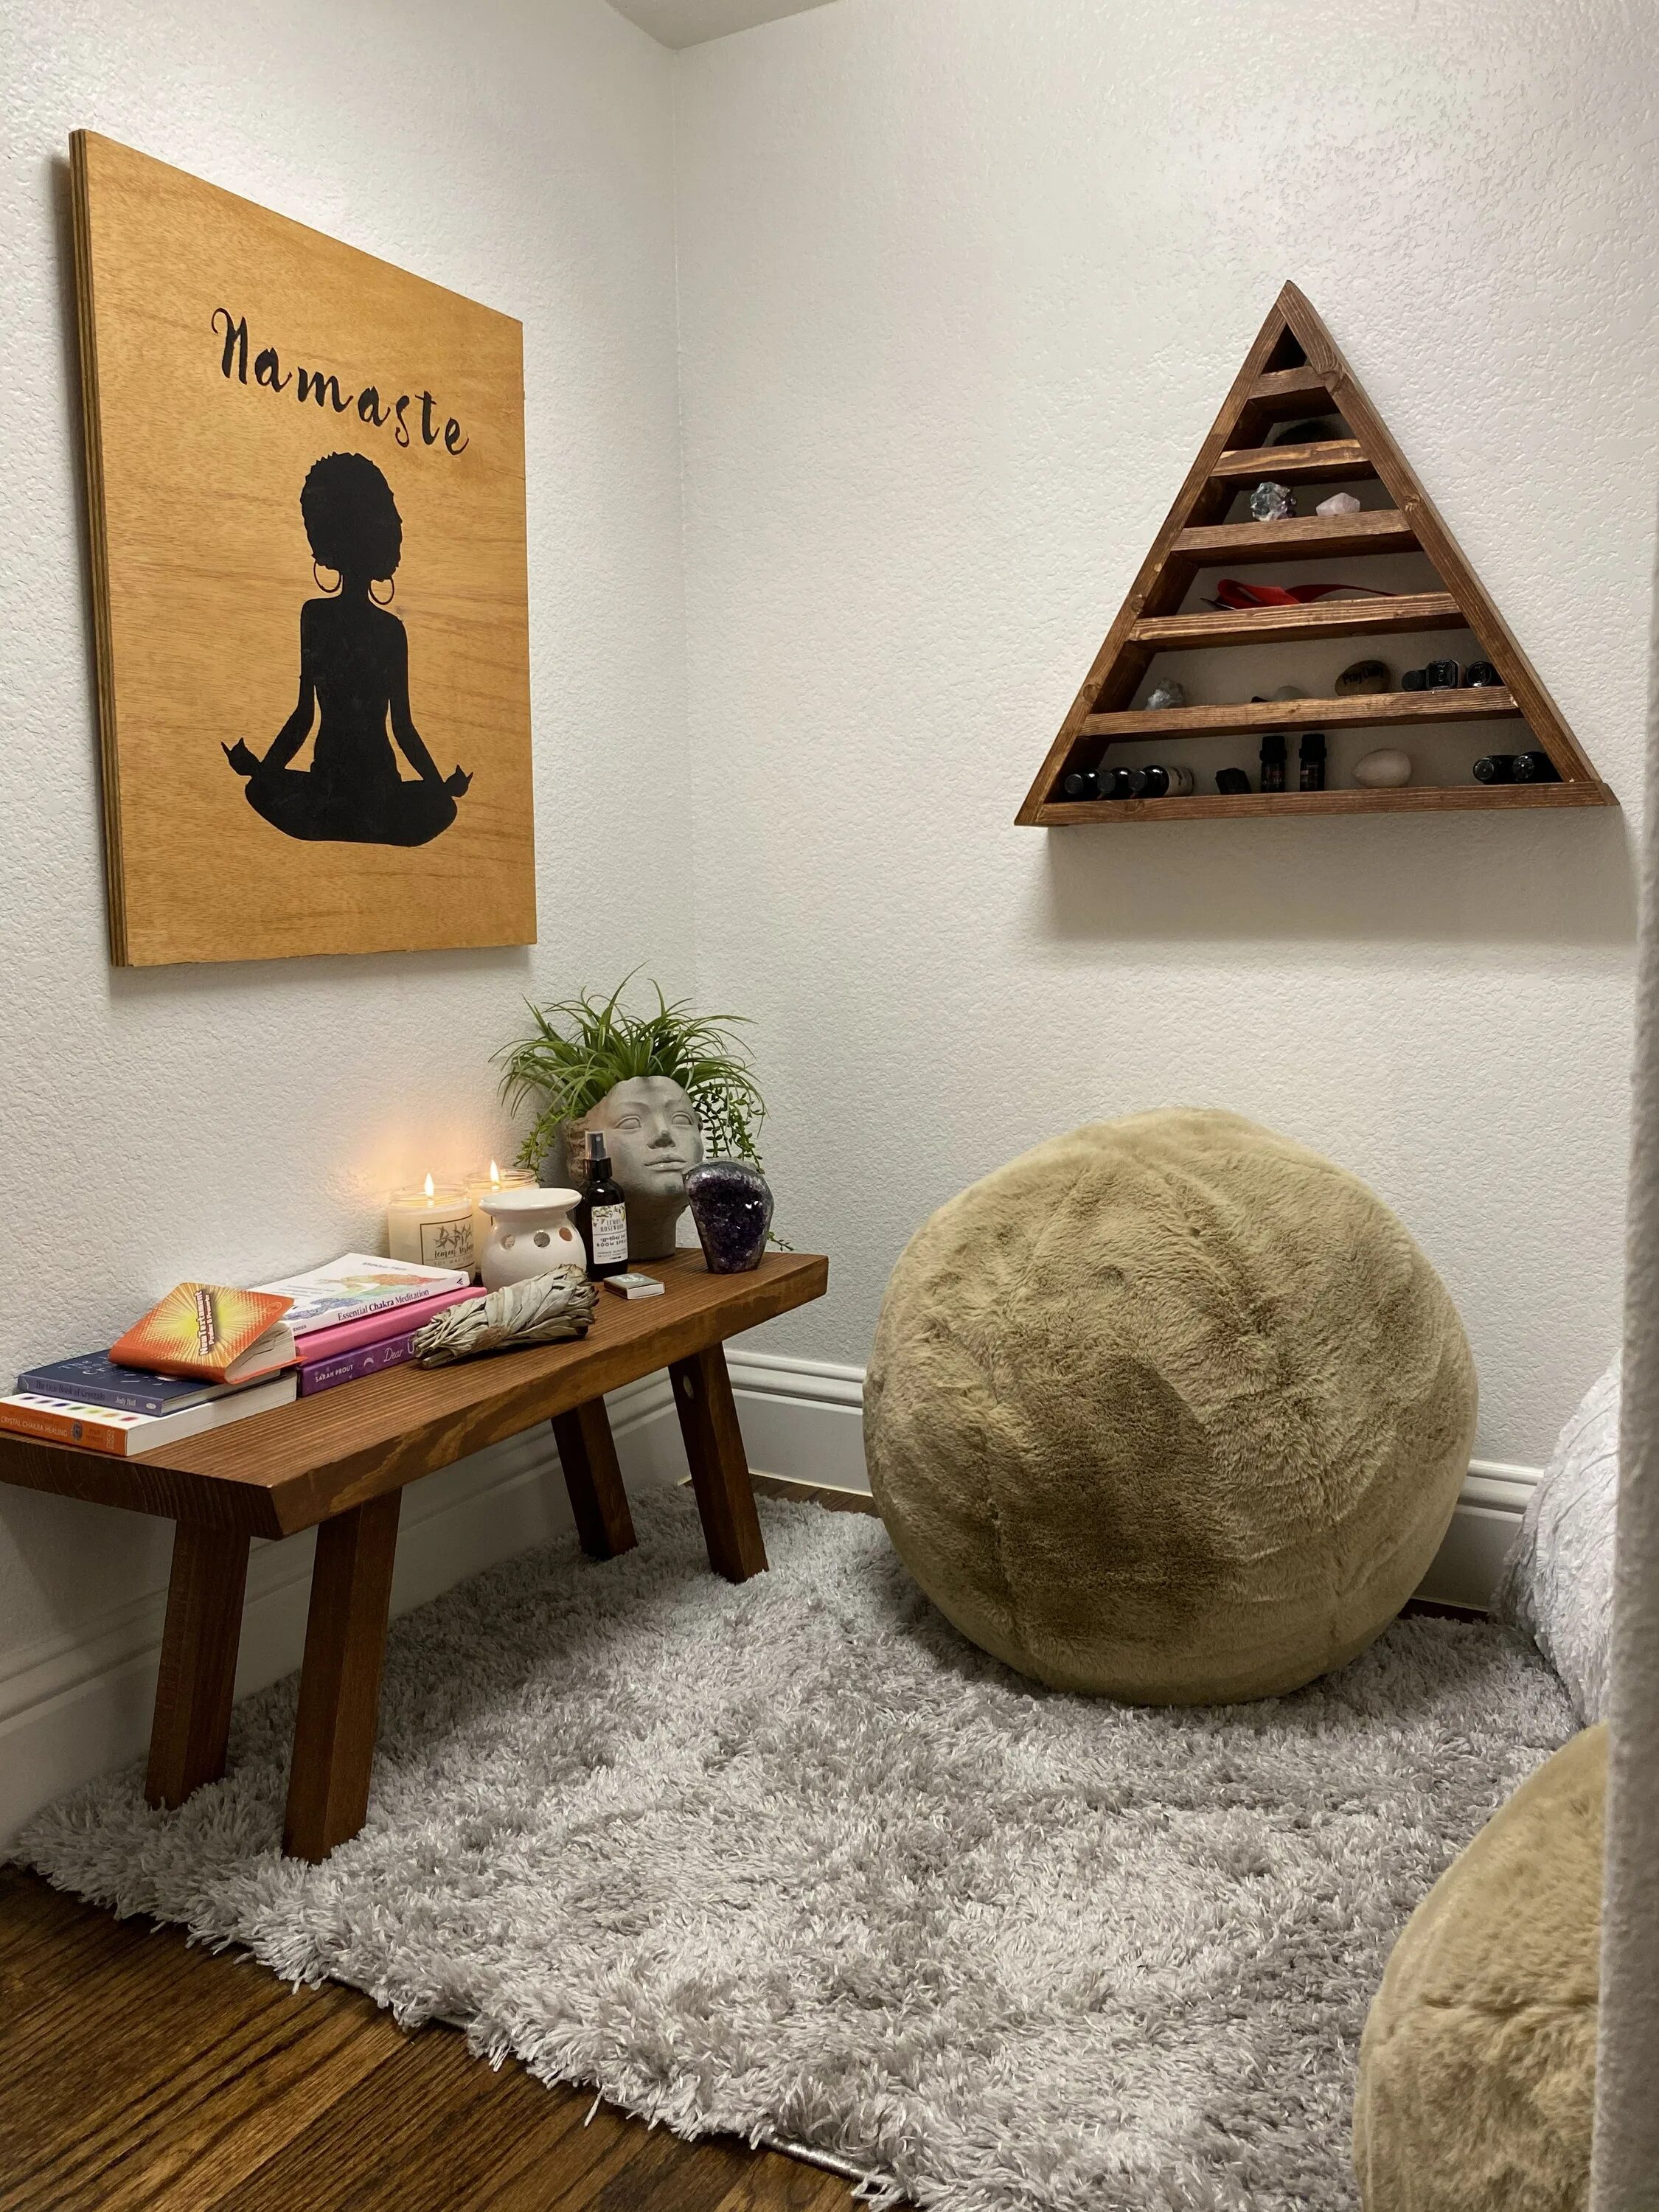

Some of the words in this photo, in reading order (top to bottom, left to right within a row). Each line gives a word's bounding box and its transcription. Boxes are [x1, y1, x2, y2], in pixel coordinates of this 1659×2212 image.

[212, 307, 470, 456] Namaste
[338, 1305, 369, 1321] Essential
[369, 1299, 394, 1312] Chakra
[395, 1289, 430, 1304] Meditation
[315, 1371, 335, 1382] SARAH
[335, 1365, 354, 1376] PROUT
[0, 1416, 21, 1427] CRYSTAL
[22, 1420, 44, 1431] CHAKRA
[45, 1426, 69, 1438] HEALING
